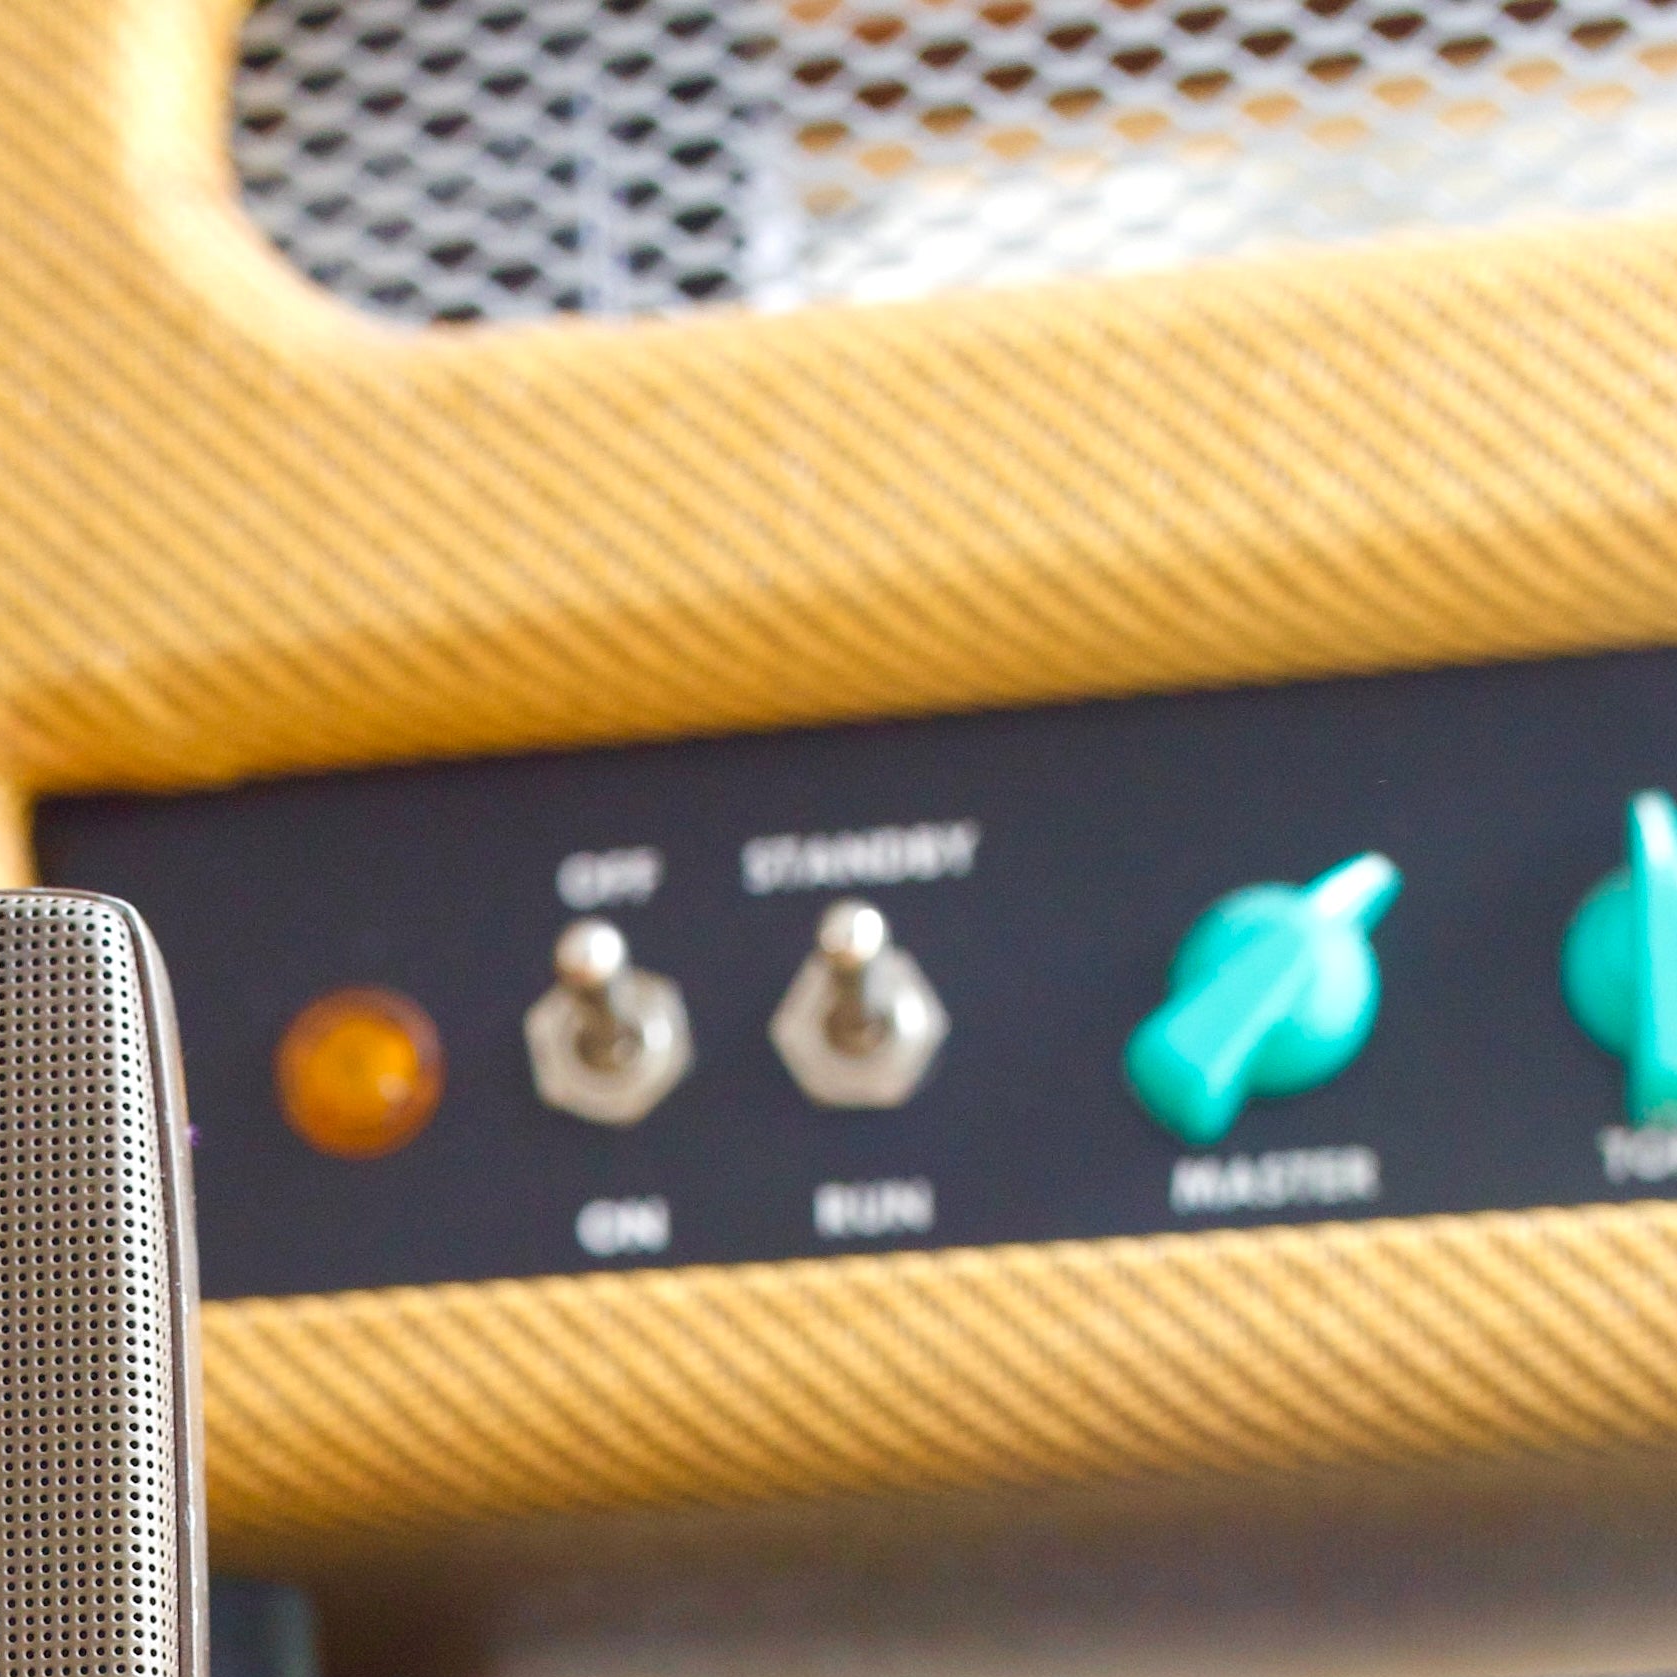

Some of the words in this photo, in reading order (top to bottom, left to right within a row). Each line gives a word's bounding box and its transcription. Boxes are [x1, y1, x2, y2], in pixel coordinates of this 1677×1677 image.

[557, 846, 664, 909] OFF
[744, 820, 979, 891] STANDBY
[814, 1179, 935, 1238] RUN
[1171, 1148, 1379, 1214] MASTER
[575, 1198, 670, 1257] ON
